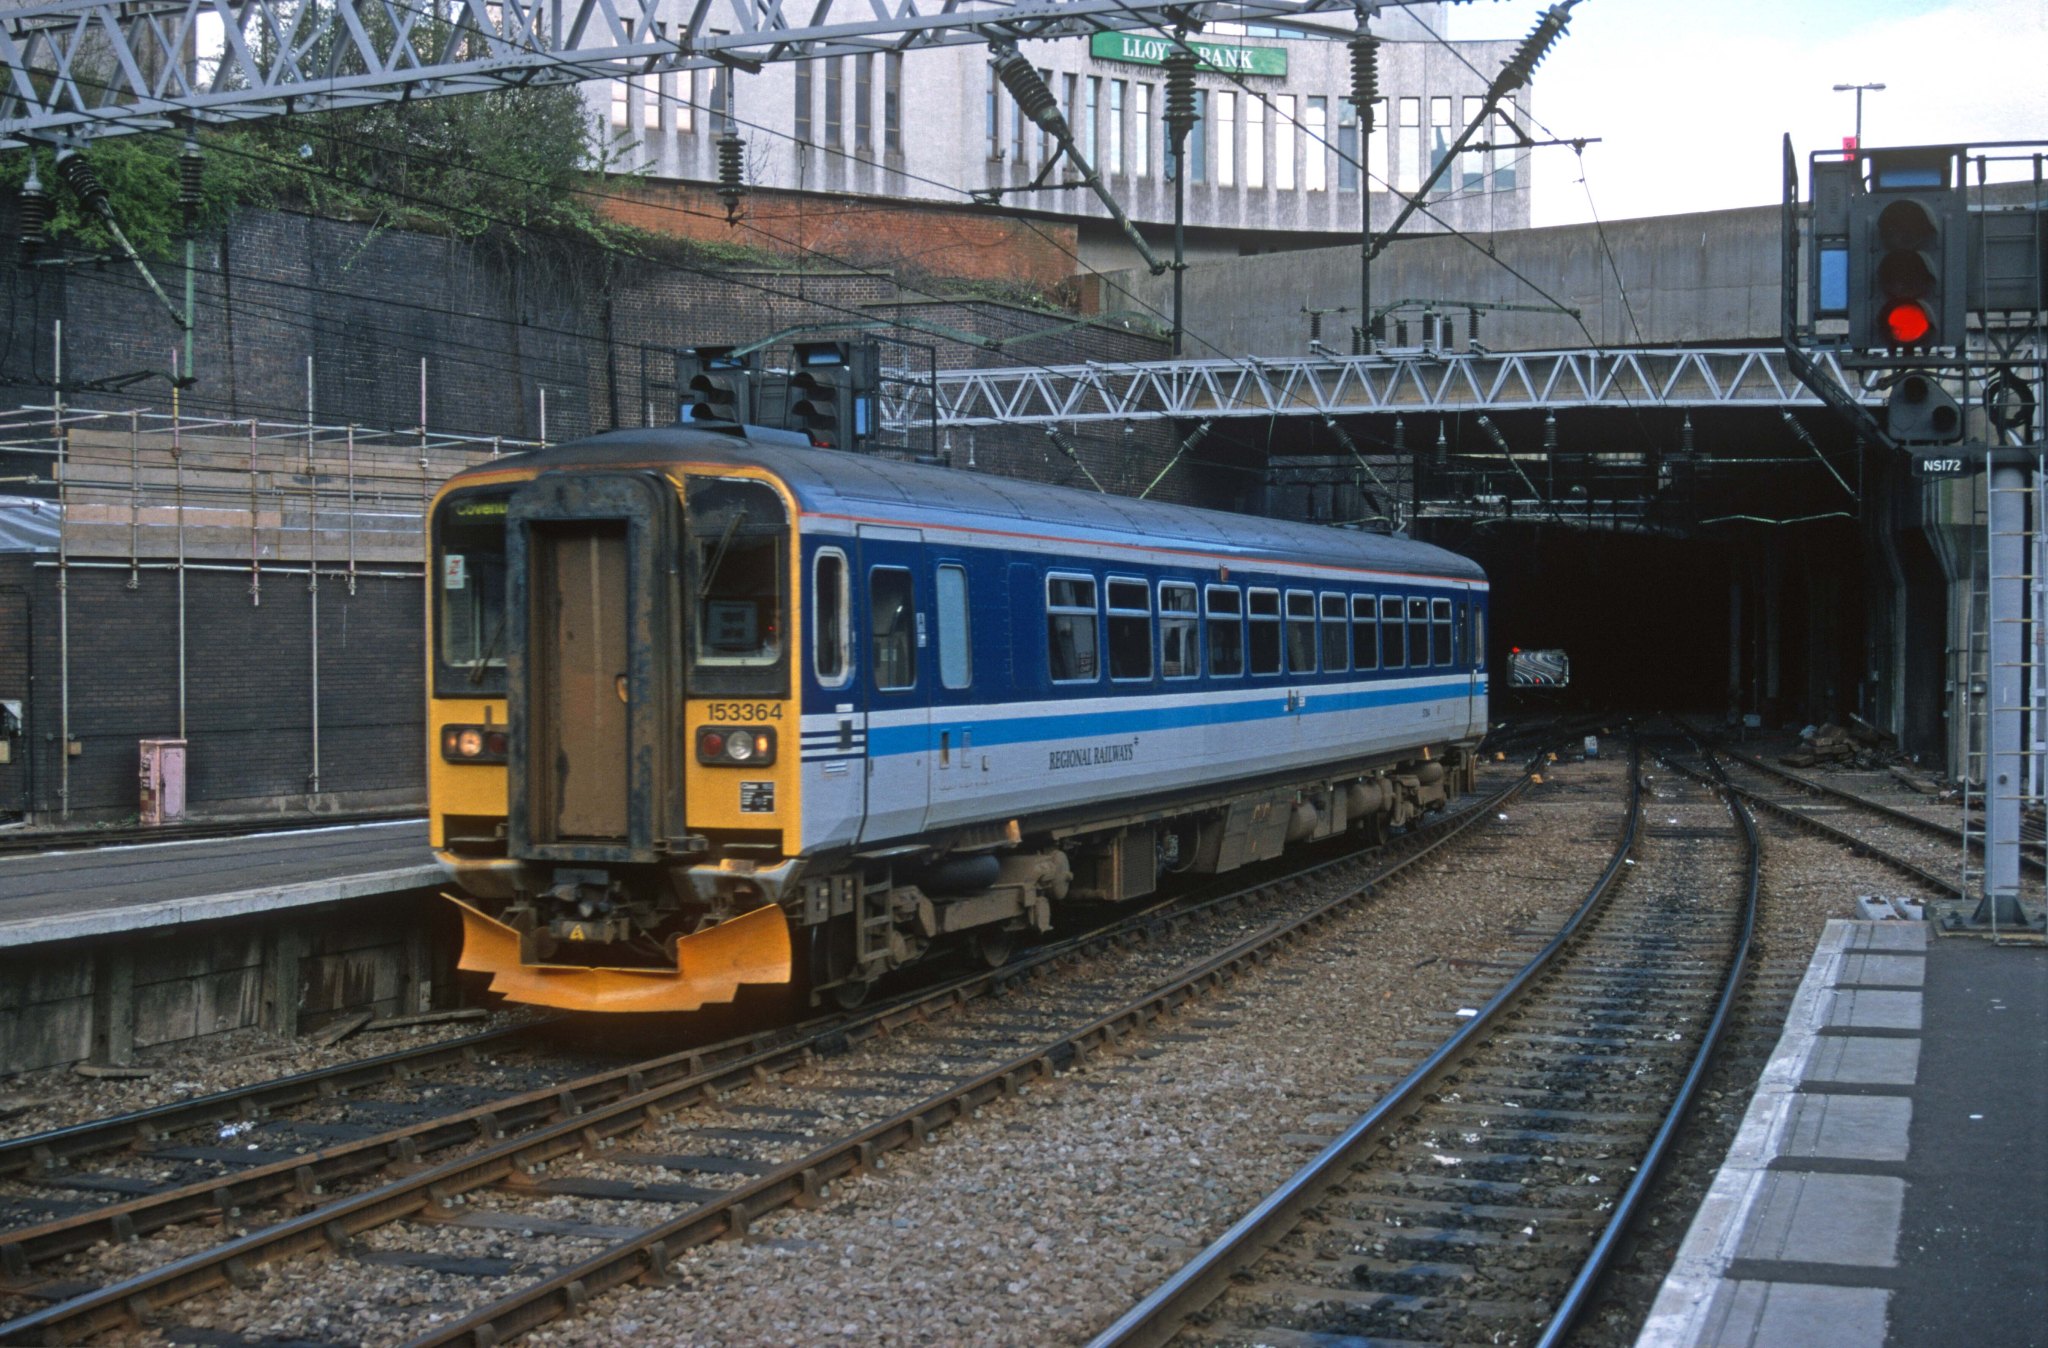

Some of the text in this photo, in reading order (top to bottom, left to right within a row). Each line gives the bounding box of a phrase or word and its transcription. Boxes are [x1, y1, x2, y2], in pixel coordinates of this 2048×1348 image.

[1122, 37, 1253, 69] LLOY BANK
[1923, 459, 1962, 472] NS172
[707, 703, 783, 721] 153364
[1048, 743, 1133, 770] REGIONAL RAILWAYS
